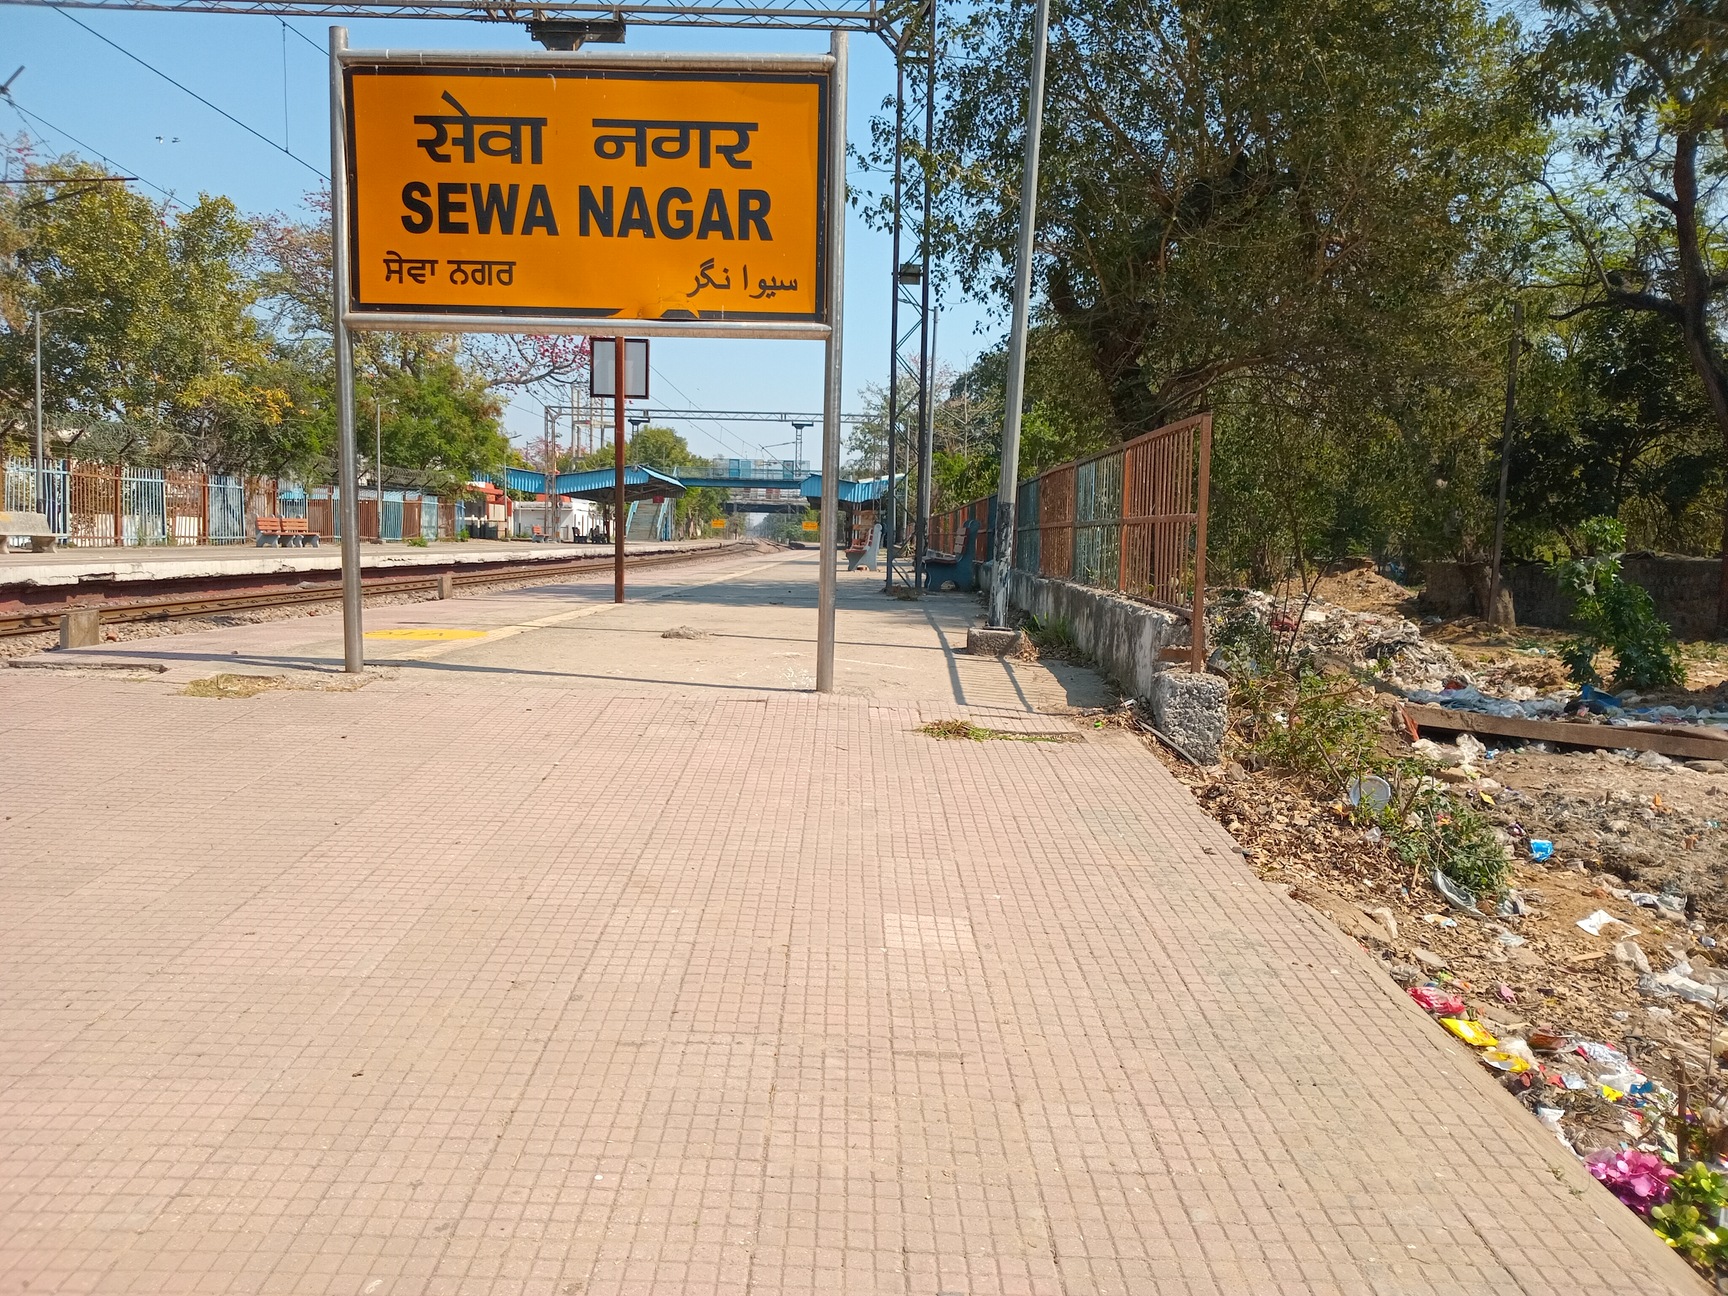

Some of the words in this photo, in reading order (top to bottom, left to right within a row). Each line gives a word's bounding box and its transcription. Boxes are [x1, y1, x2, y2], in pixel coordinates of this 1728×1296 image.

[413, 89, 548, 165] सेवा
[591, 118, 759, 170] नगर
[400, 180, 560, 237] SEWA
[578, 184, 774, 242] NAGAR
[382, 250, 439, 285] ਸੇਵਾ
[446, 259, 517, 287] ਨਗਰ
[686, 257, 731, 298] نگر
